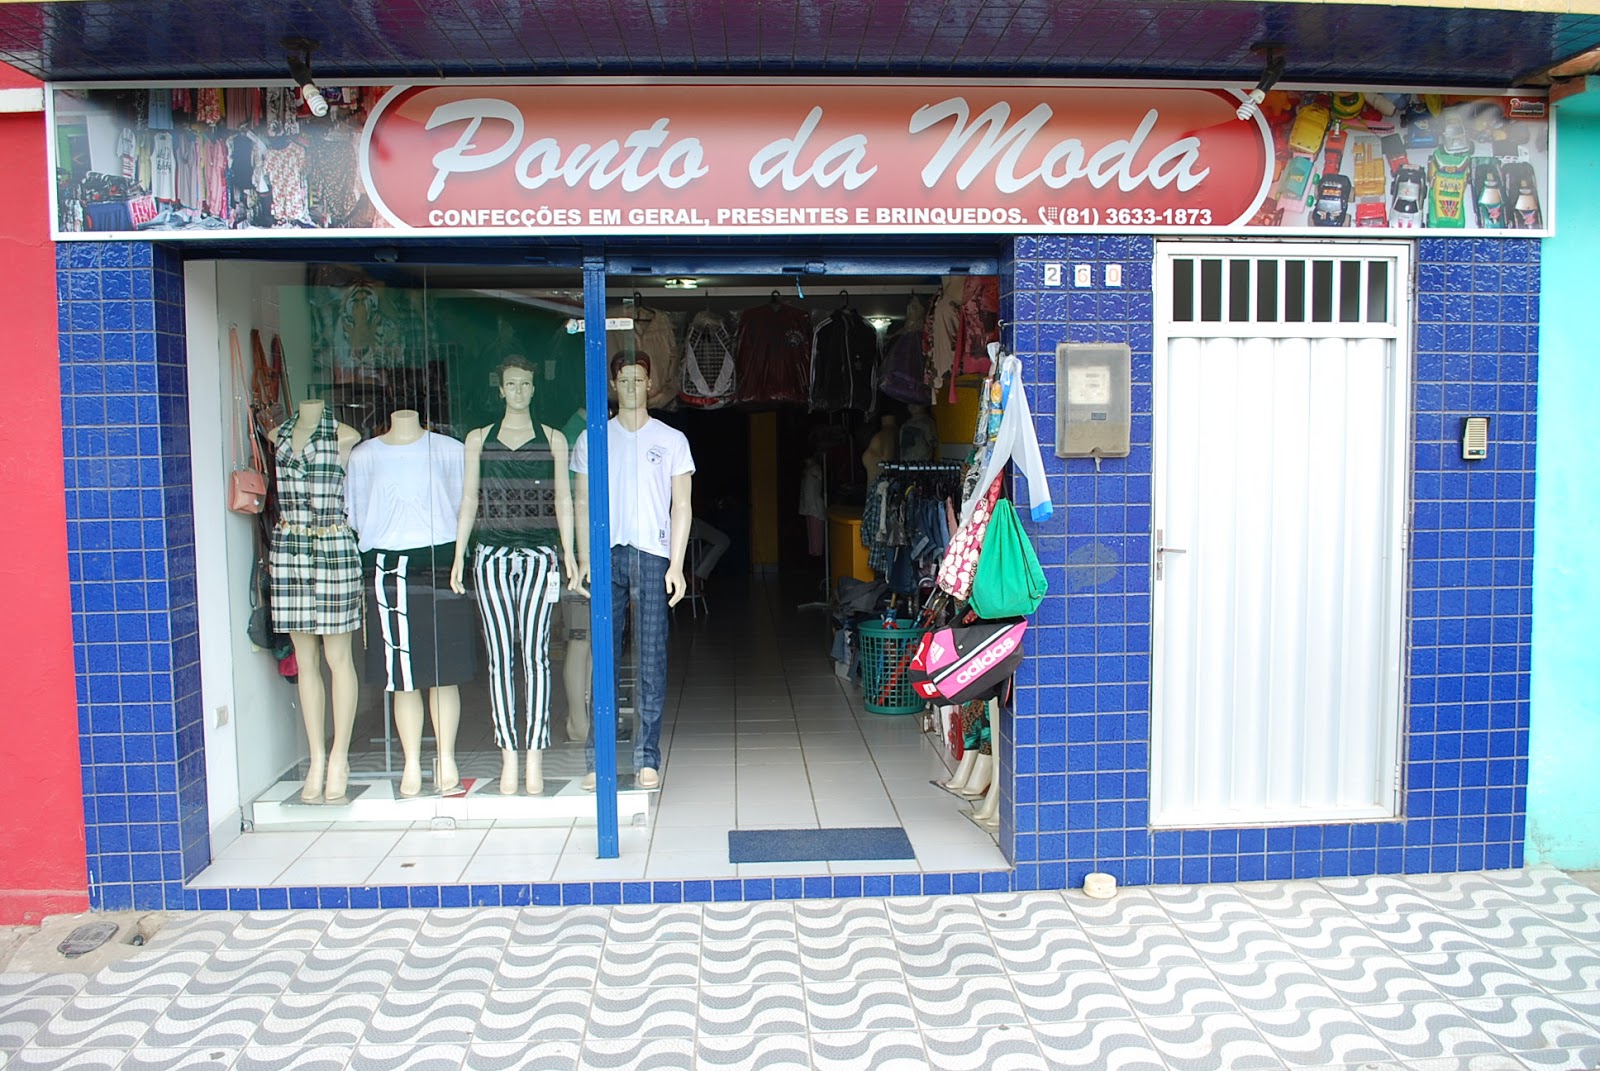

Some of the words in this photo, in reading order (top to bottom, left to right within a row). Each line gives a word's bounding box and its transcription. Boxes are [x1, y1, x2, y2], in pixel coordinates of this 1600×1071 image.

[424, 97, 709, 202] Ponto
[748, 105, 878, 191] da
[908, 96, 1210, 194] Moda
[428, 205, 581, 228] CONFECÇÕES
[588, 208, 621, 226] EM
[628, 208, 709, 227] GERAL,
[716, 207, 848, 226] PRESENTES
[855, 208, 869, 225] E
[876, 207, 1028, 227] BRINQUEDOS.
[1059, 207, 1099, 227] (81)
[1105, 208, 1212, 226] 3633-1873
[956, 637, 1015, 684] adidas
